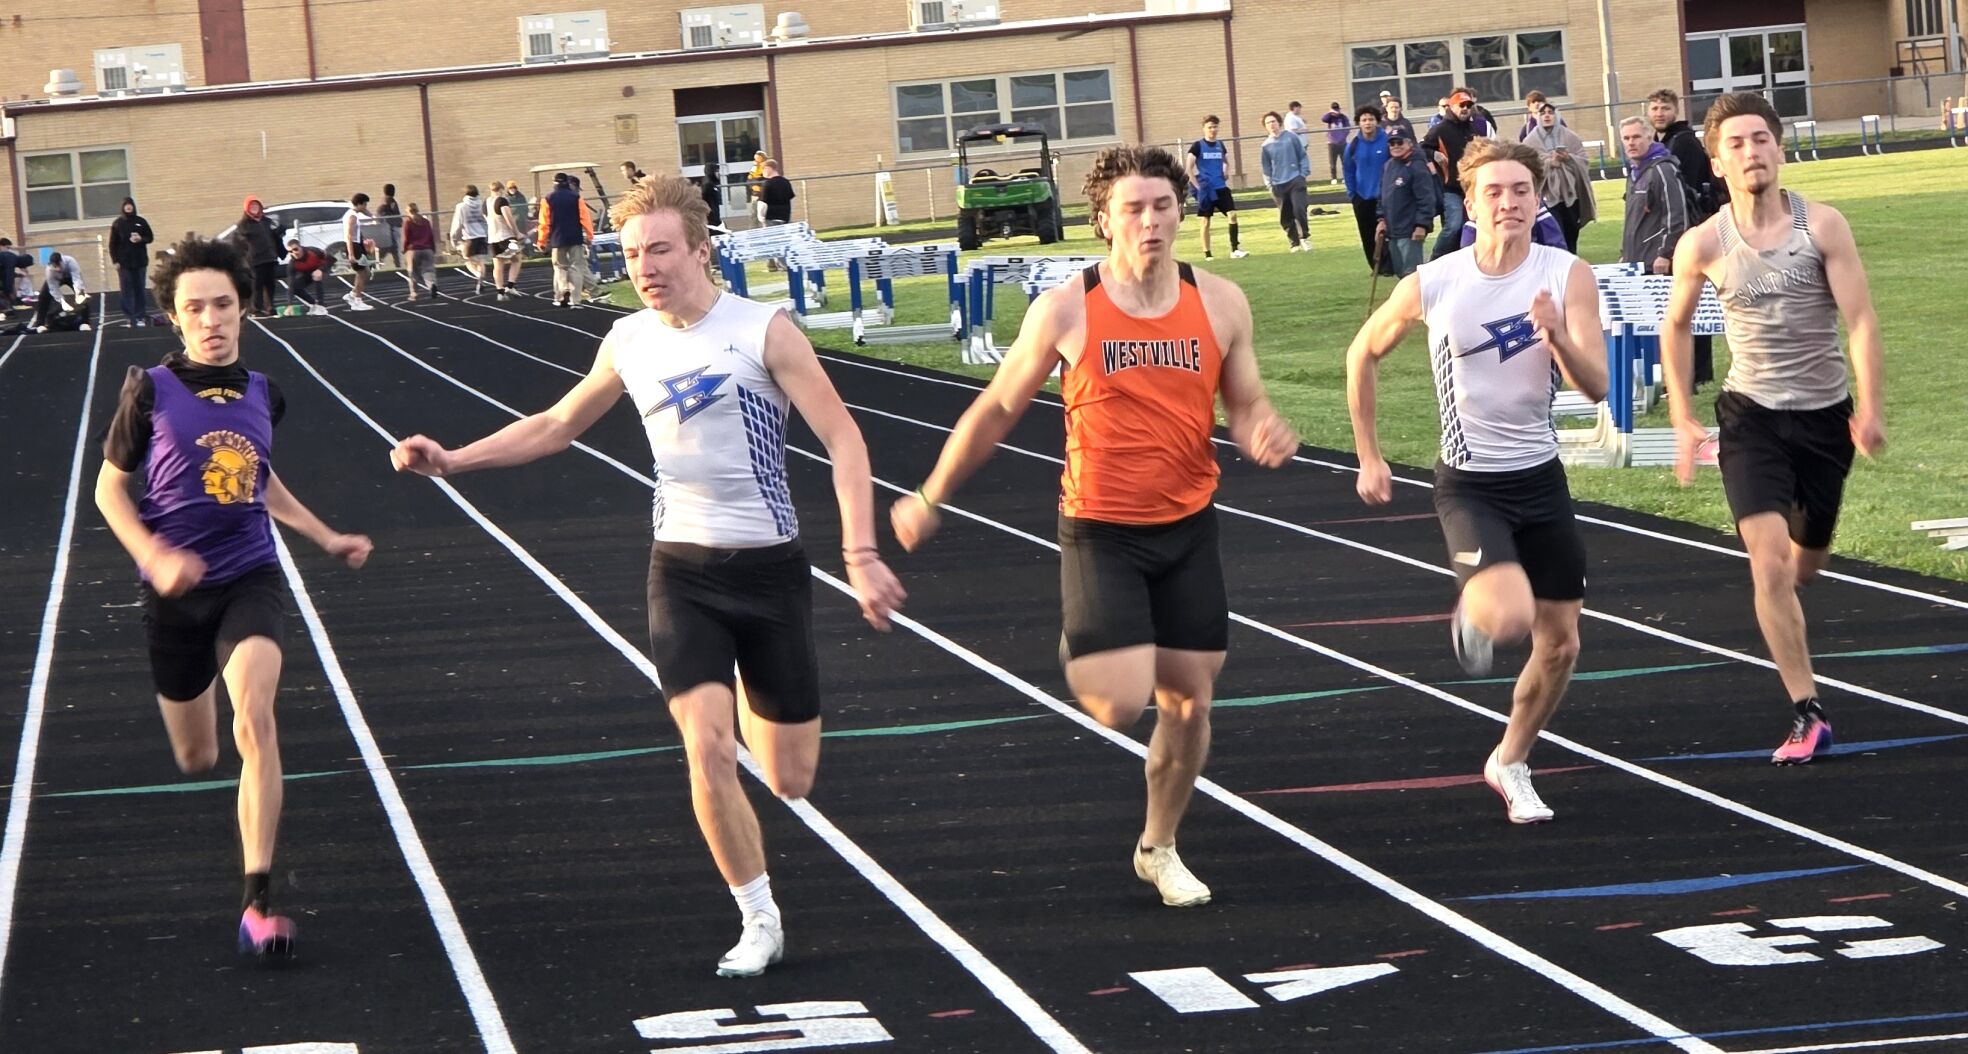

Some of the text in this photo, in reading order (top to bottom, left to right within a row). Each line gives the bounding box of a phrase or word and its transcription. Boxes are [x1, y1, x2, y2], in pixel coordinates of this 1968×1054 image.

[1734, 270, 1779, 306] SALT
[1780, 264, 1819, 287] FO
[1101, 337, 1202, 377] WESTVILLE
